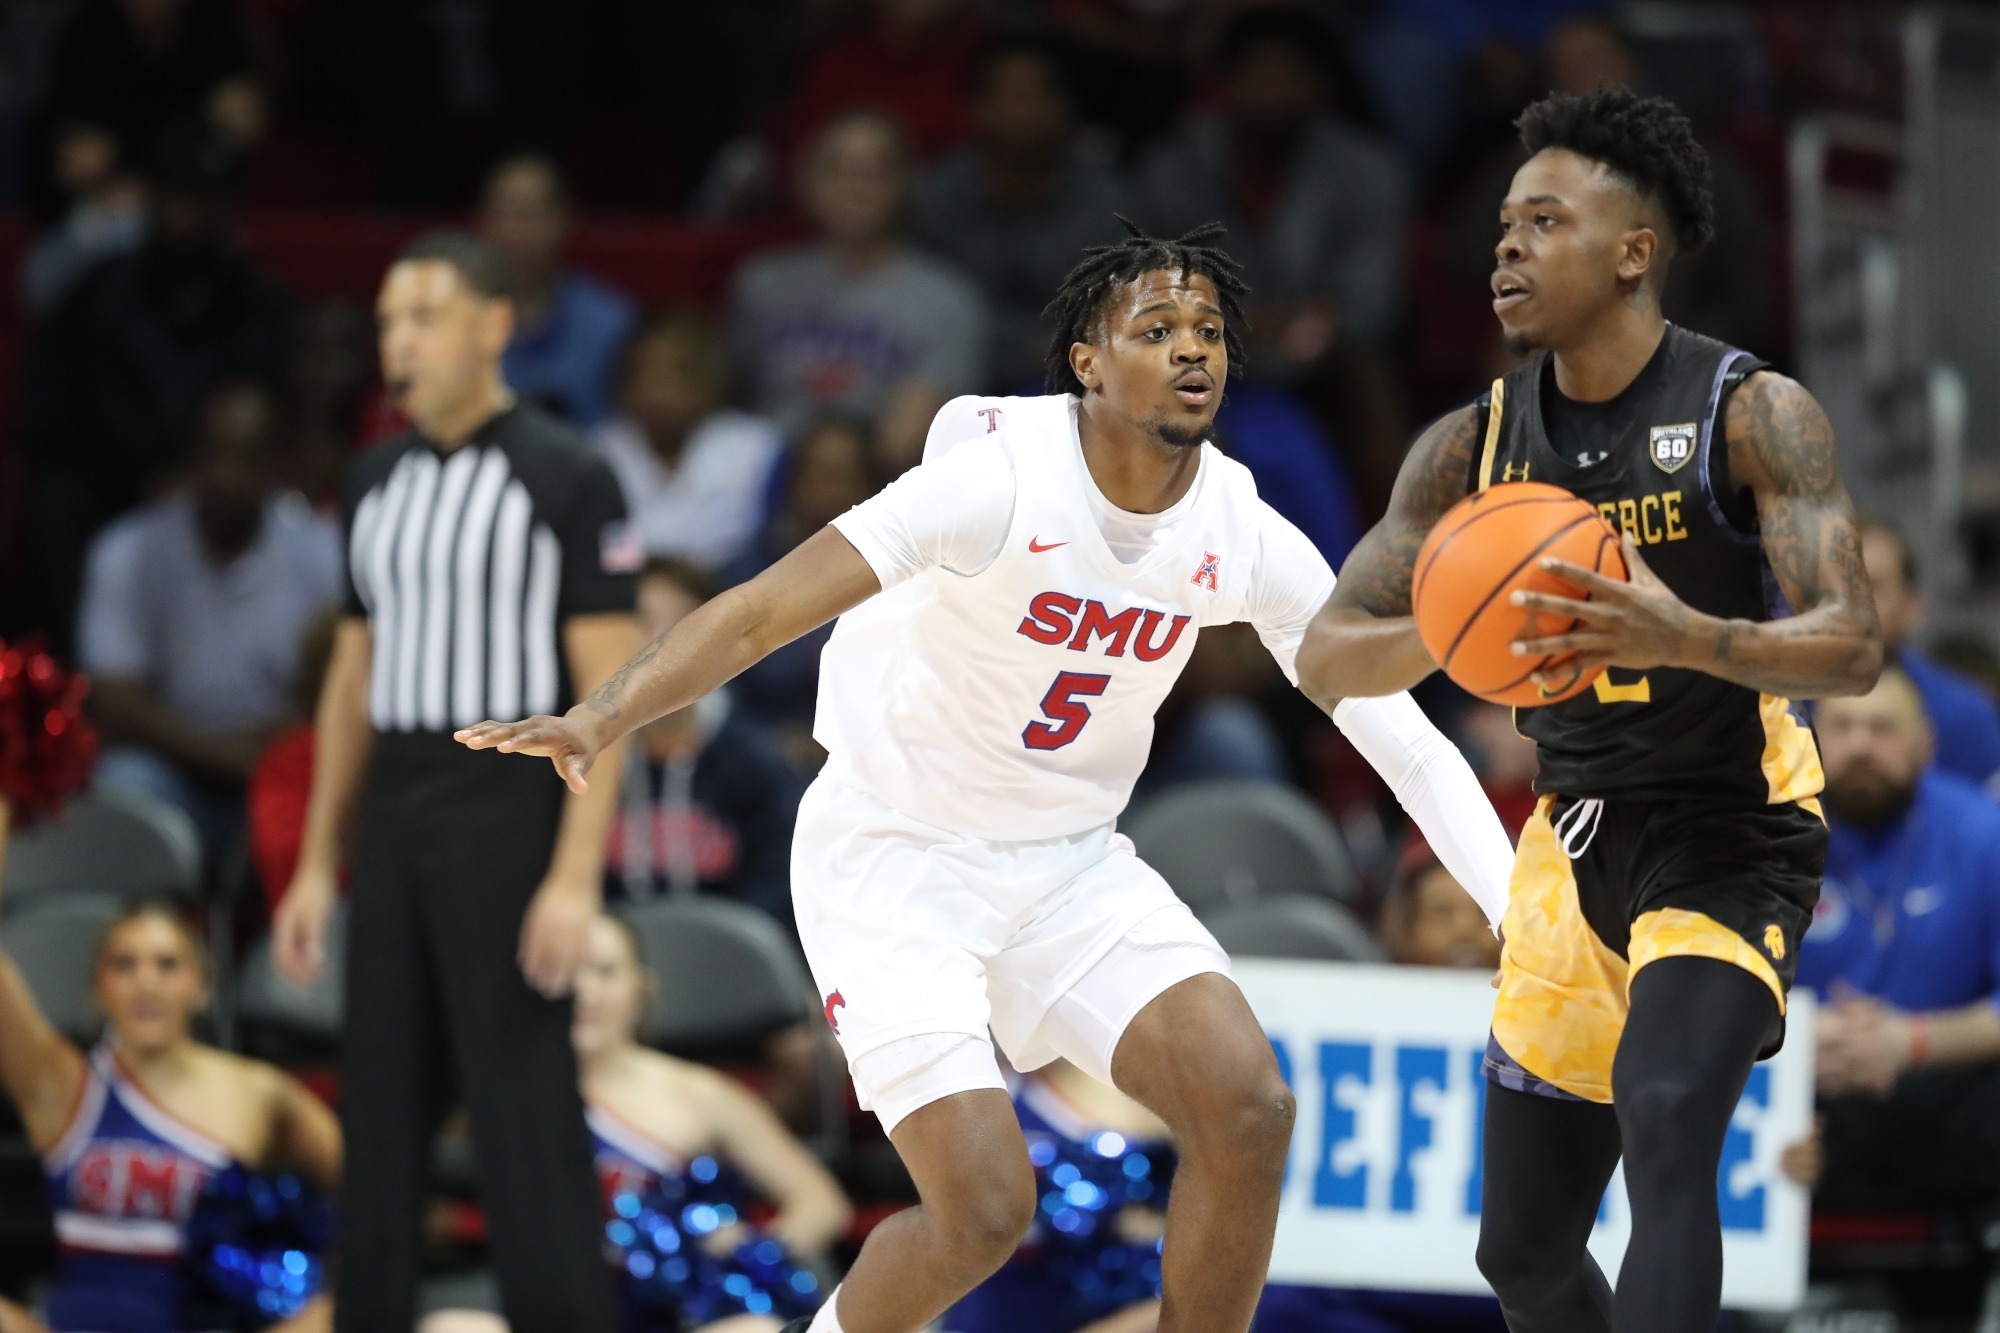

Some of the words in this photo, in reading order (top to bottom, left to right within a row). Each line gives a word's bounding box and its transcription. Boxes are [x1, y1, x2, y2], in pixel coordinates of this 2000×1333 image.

[1656, 438, 1688, 459] 60
[1017, 591, 1192, 662] SMU
[1021, 671, 1112, 751] 5
[70, 1142, 208, 1216] SM
